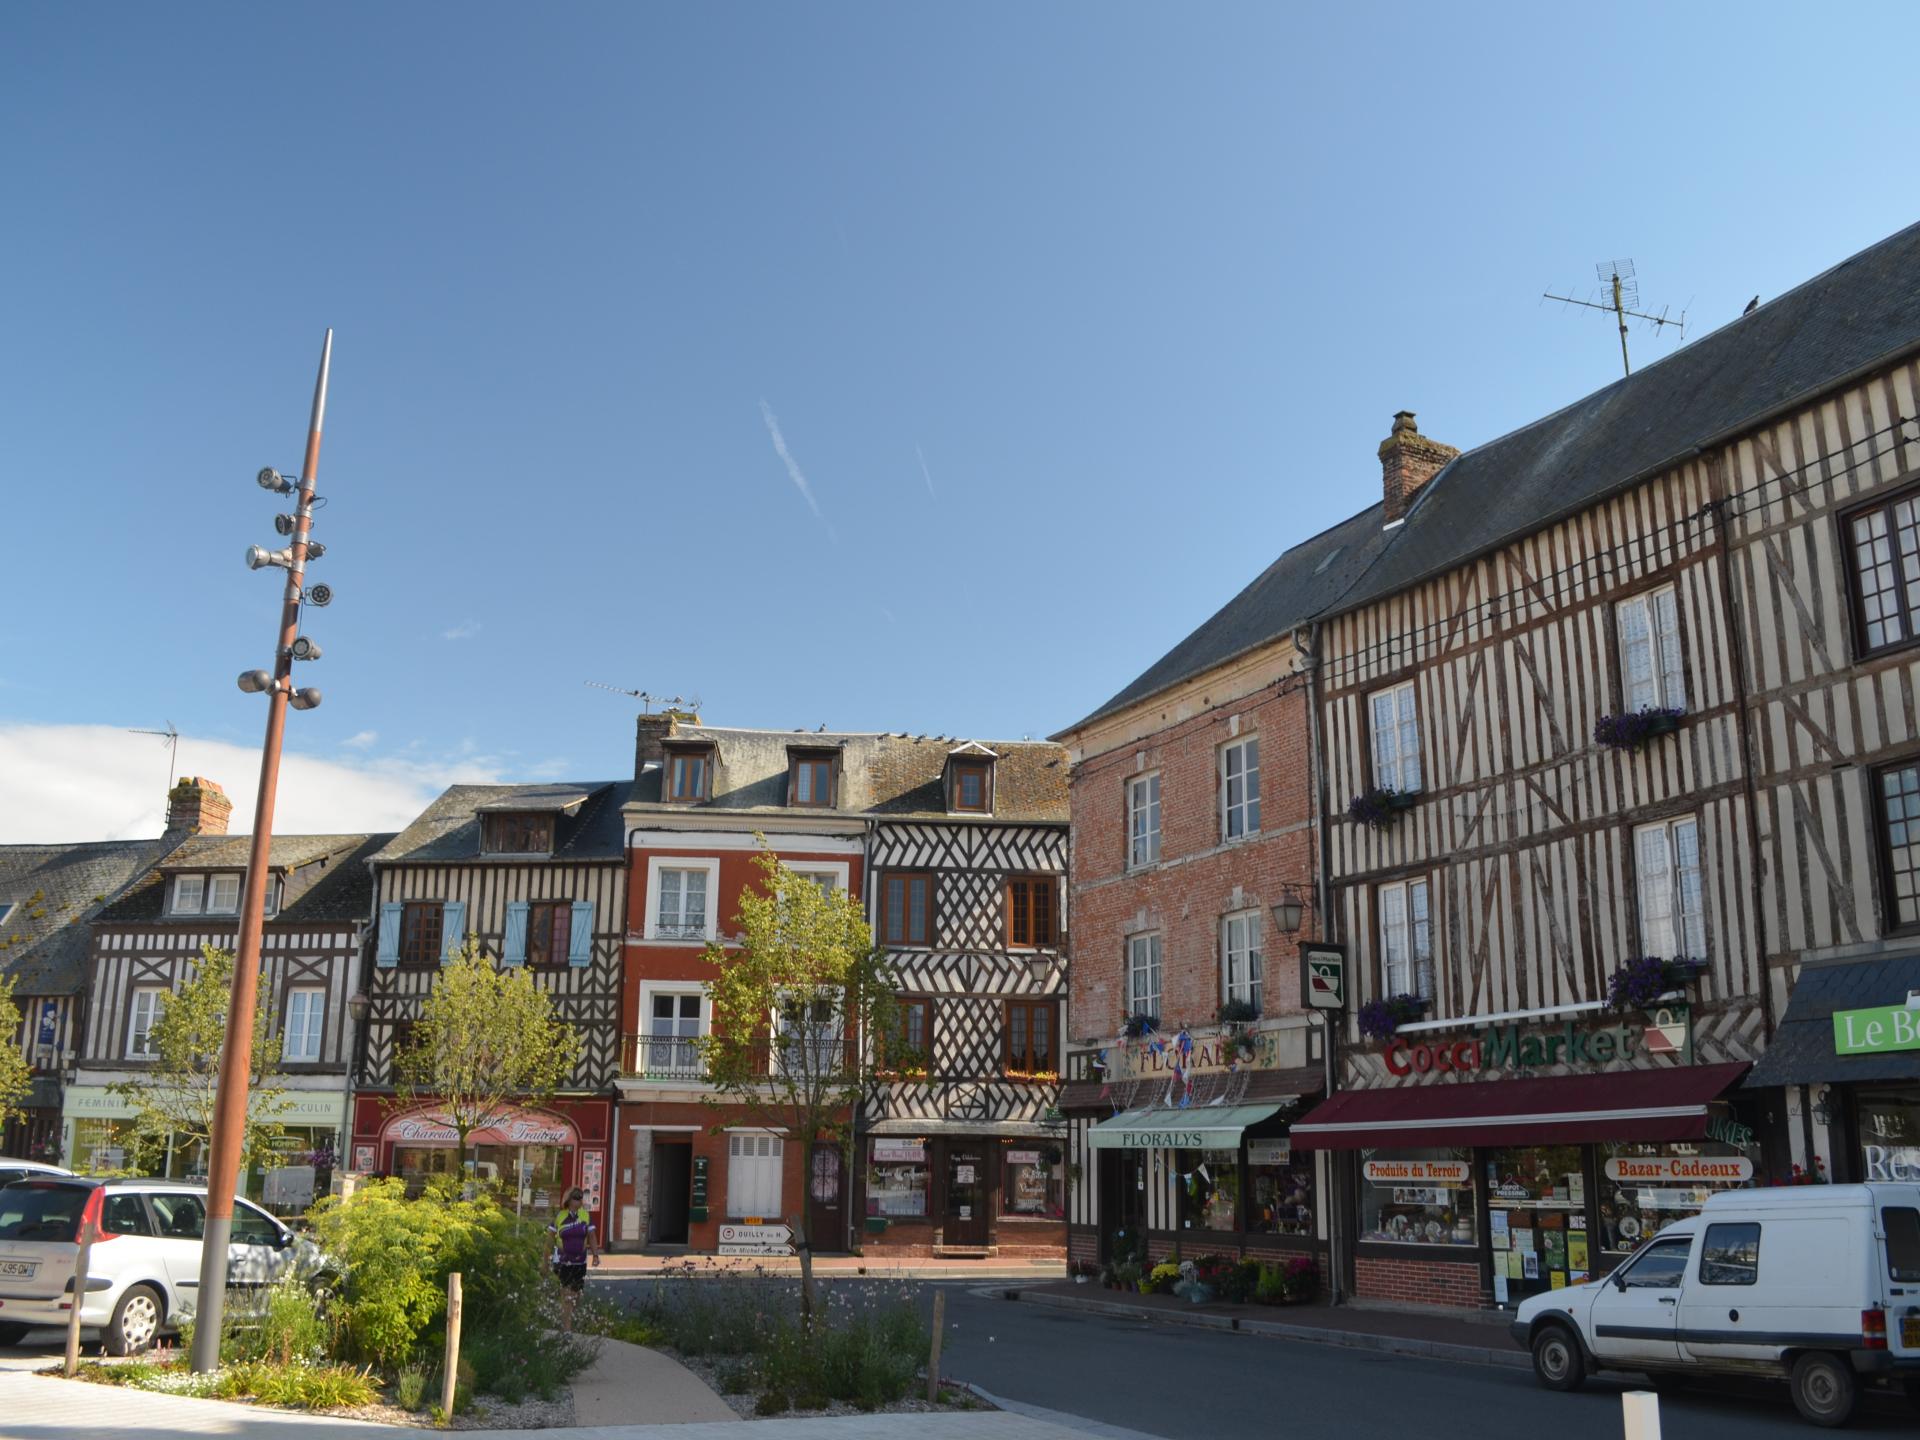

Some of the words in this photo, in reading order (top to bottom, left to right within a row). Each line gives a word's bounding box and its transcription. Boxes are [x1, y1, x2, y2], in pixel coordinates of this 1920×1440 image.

[1844, 1014, 1884, 1049] Le
[511, 1122, 567, 1141] Traiteur
[1122, 1132, 1203, 1147] FLORALYS
[1369, 1163, 1408, 1177] Produits
[1411, 1163, 1423, 1177] du
[1426, 1163, 1462, 1177] Terroir
[1617, 1159, 1741, 1177] Bazar-Cadeaux
